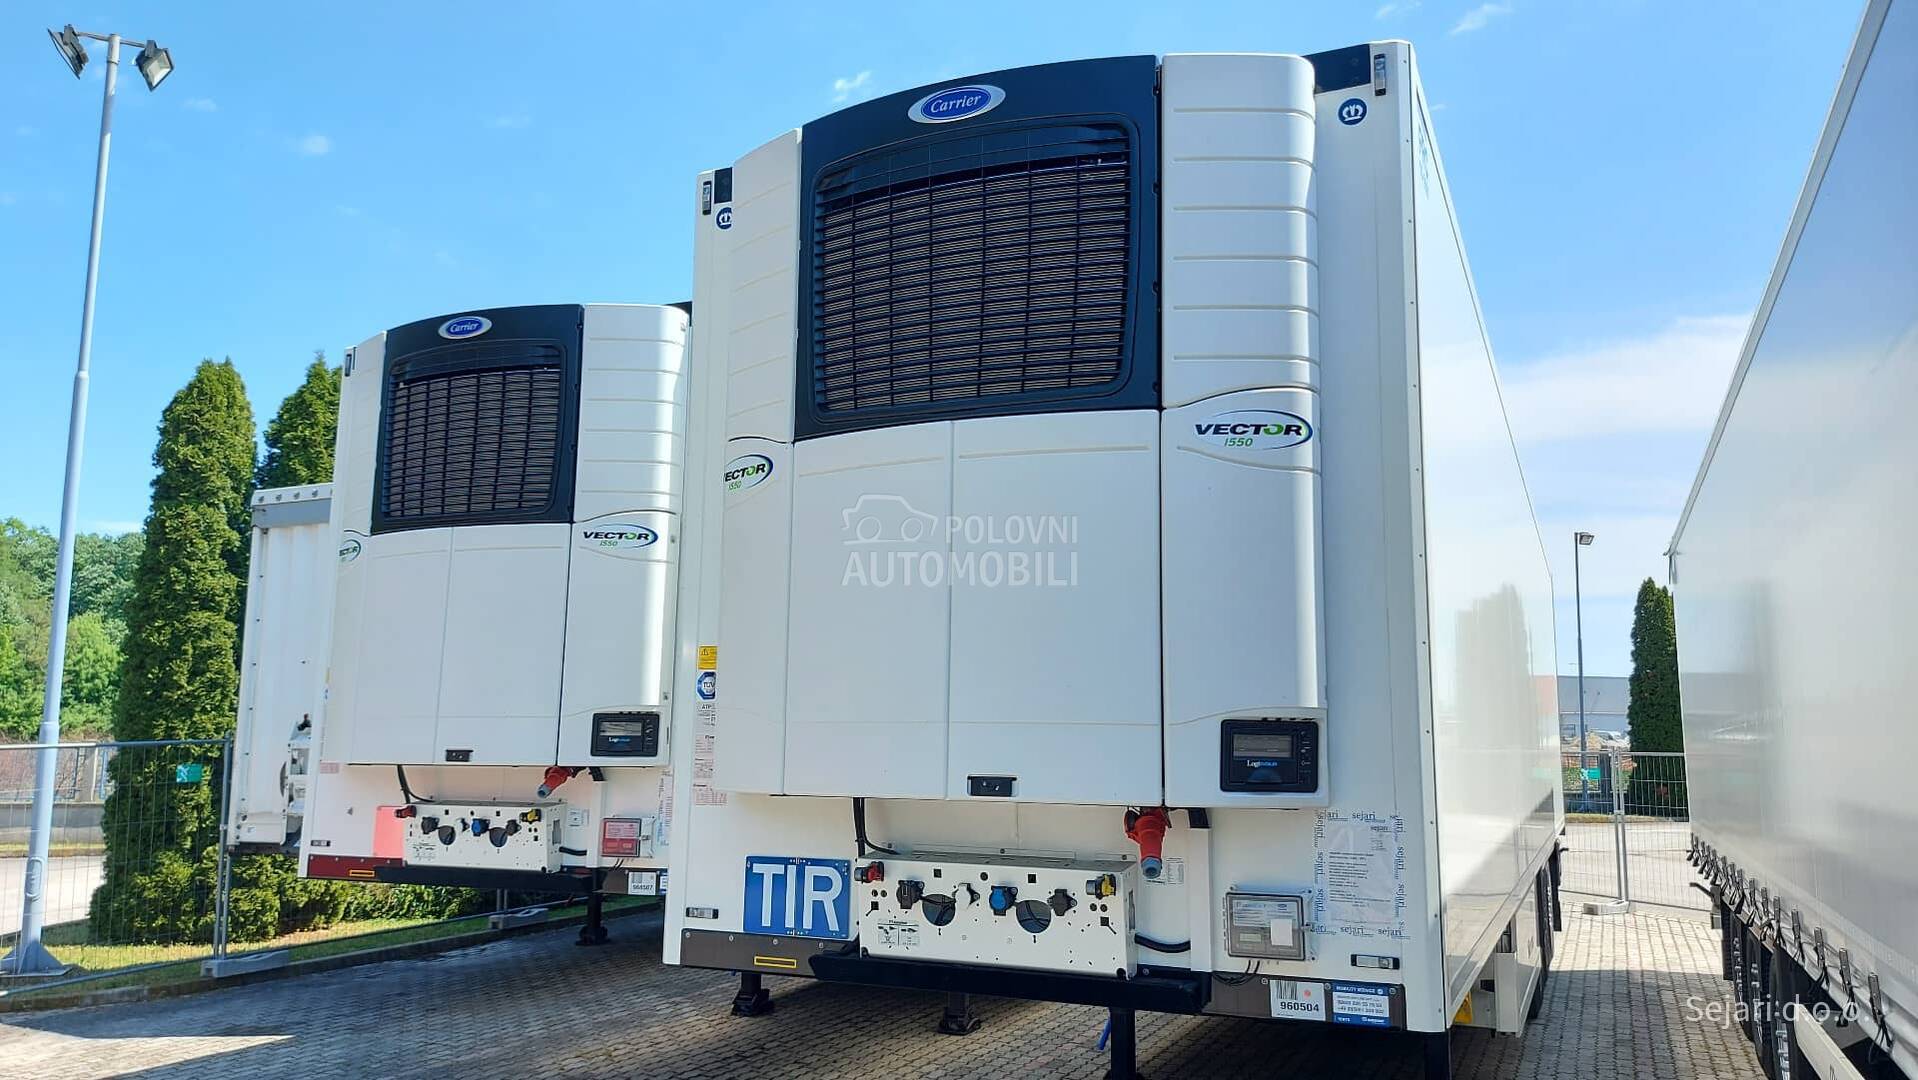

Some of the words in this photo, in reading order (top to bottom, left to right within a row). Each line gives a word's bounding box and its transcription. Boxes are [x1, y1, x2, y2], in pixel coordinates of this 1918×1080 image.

[930, 95, 982, 113] Carrier
[1195, 423, 1303, 436] VECTOR
[1224, 438, 1253, 447] 1550
[724, 463, 766, 482] ECTOR
[583, 531, 650, 541] VECTOR
[1352, 809, 1376, 821] sejari
[752, 863, 843, 931] TIR
[1340, 925, 1364, 935] sejari
[1378, 927, 1402, 937] sejari
[1280, 1001, 1319, 1012] 960504
